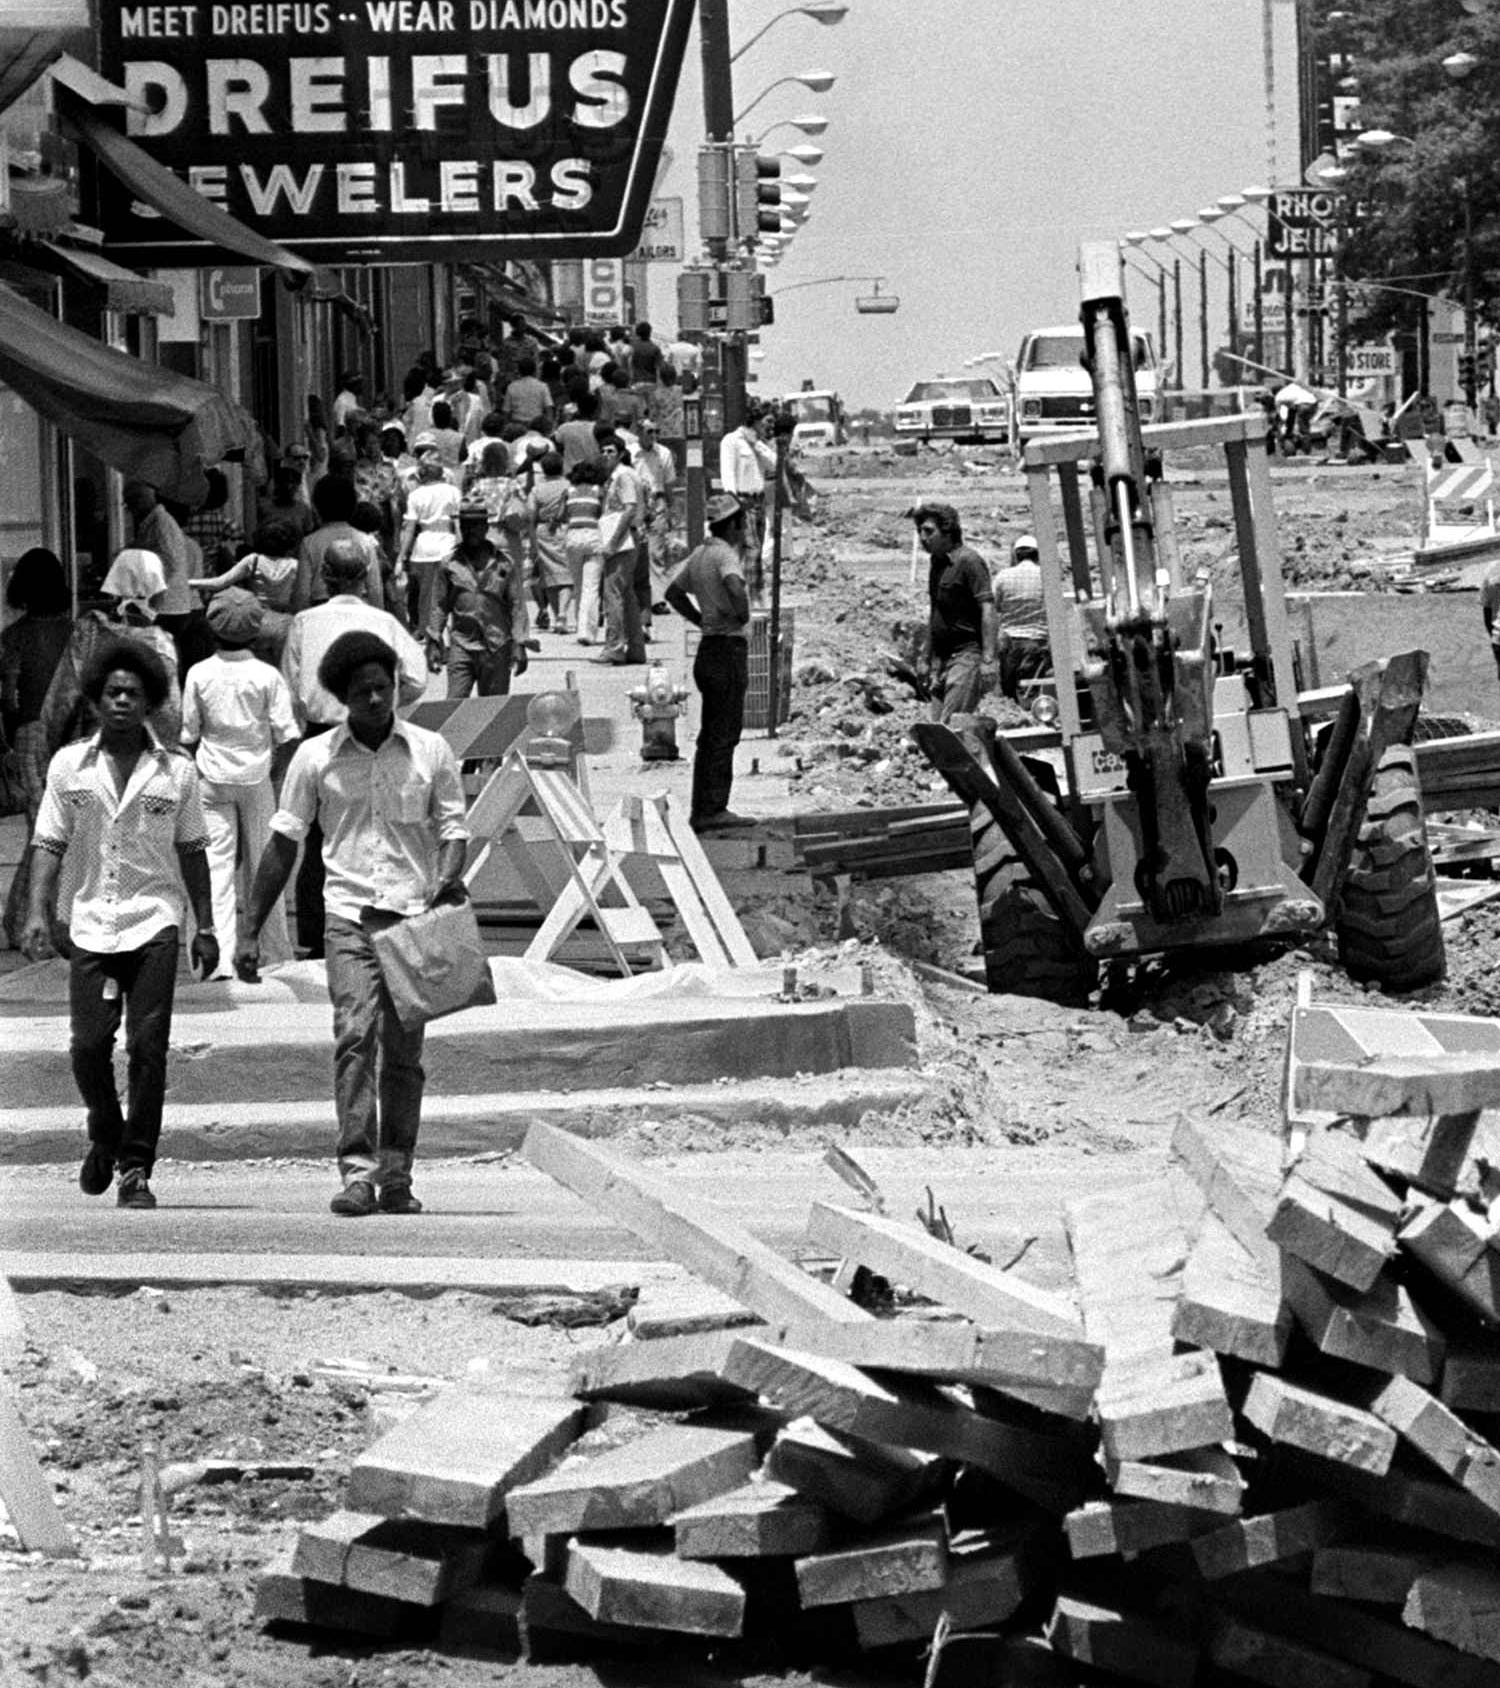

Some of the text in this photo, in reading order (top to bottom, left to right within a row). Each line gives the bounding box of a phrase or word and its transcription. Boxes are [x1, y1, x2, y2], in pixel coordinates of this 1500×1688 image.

[121, 0, 627, 37] MEET DREIFUS WEAR DIAMONDS
[123, 50, 630, 137] DREIFUS
[130, 158, 593, 217] EWELERS
[219, 280, 254, 295] phone
[1357, 351, 1392, 370] STORE
